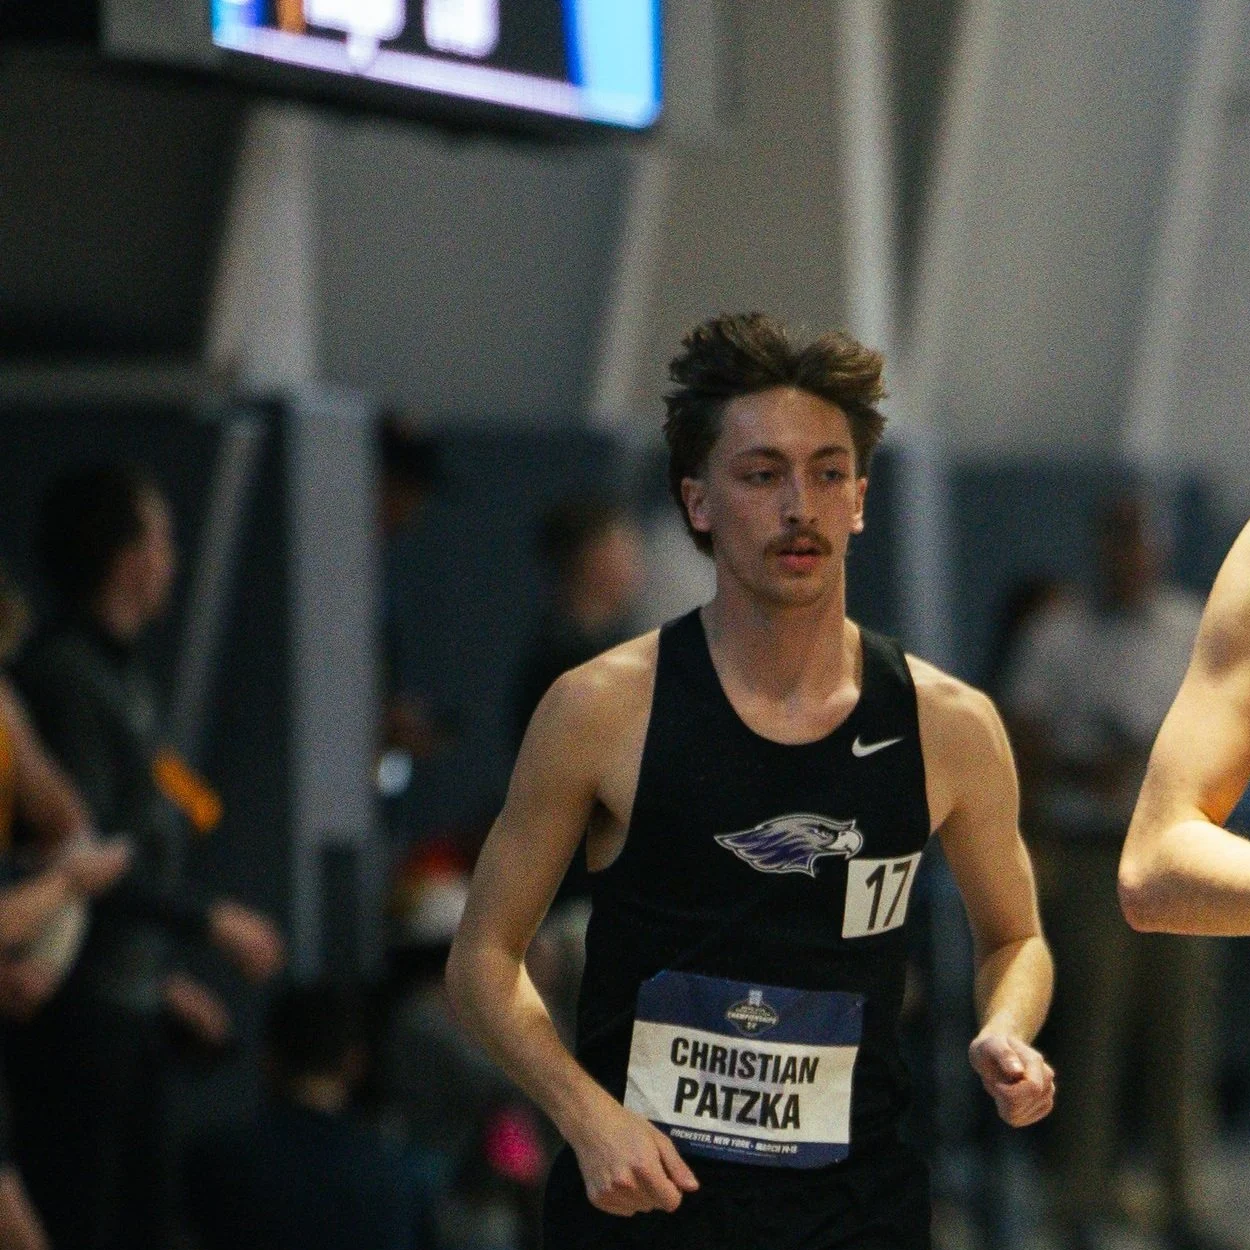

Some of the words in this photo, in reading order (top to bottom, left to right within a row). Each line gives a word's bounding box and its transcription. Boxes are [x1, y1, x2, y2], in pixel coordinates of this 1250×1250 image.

[865, 863, 911, 931] 17
[670, 1037, 820, 1084] CHRISTIAN
[674, 1077, 801, 1129] PATZKA
[713, 1136, 730, 1146] NEW
[731, 1138, 750, 1149] YORK
